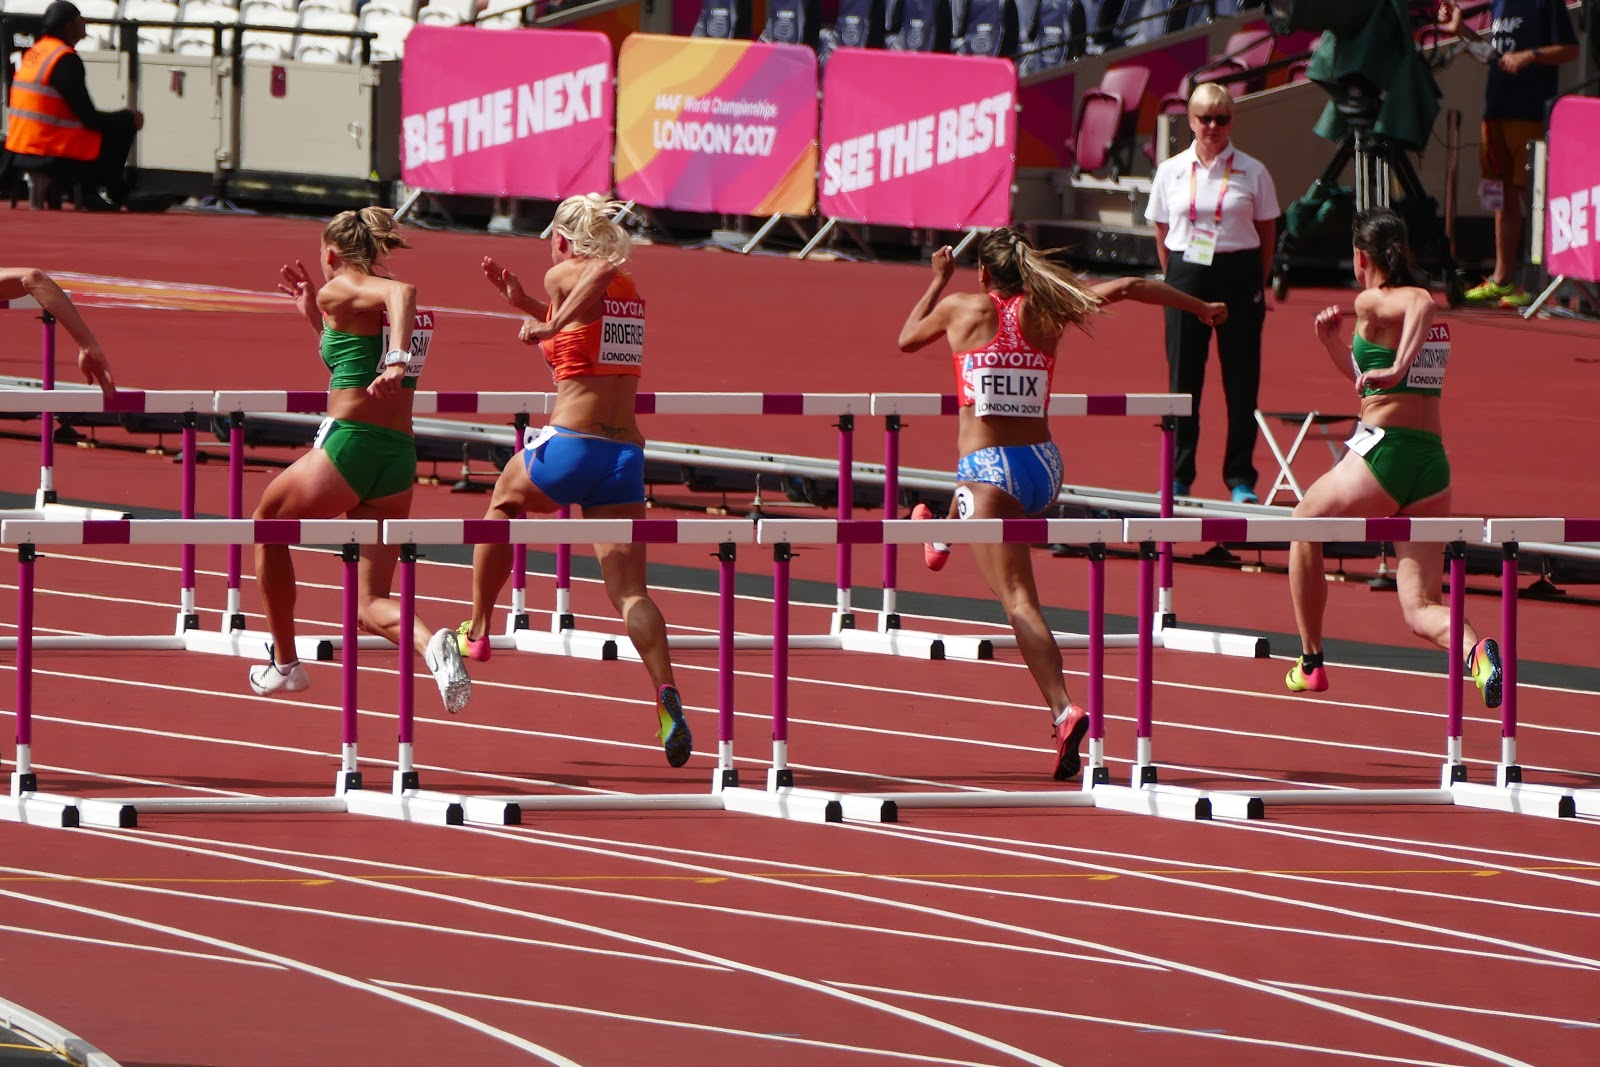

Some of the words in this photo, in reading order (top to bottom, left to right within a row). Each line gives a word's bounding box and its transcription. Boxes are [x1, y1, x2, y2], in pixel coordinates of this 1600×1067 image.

[403, 107, 446, 170] BE
[447, 89, 513, 157] THE
[516, 62, 608, 139] NEXT
[655, 95, 682, 111] IAAF
[683, 96, 710, 114] World
[711, 97, 777, 120] Championships
[653, 120, 731, 154] LONDON
[732, 124, 777, 157] 2017
[823, 134, 874, 196] SEE
[877, 115, 935, 182] THE
[937, 92, 1012, 165] BEST
[1550, 189, 1589, 255] BE
[604, 300, 644, 316] TOYOTA
[602, 352, 636, 362] LONDON
[974, 352, 1045, 368] TOYOTA
[981, 374, 1039, 397] FELIX
[978, 401, 1020, 413] LONDON
[1021, 404, 1042, 415] 2017
